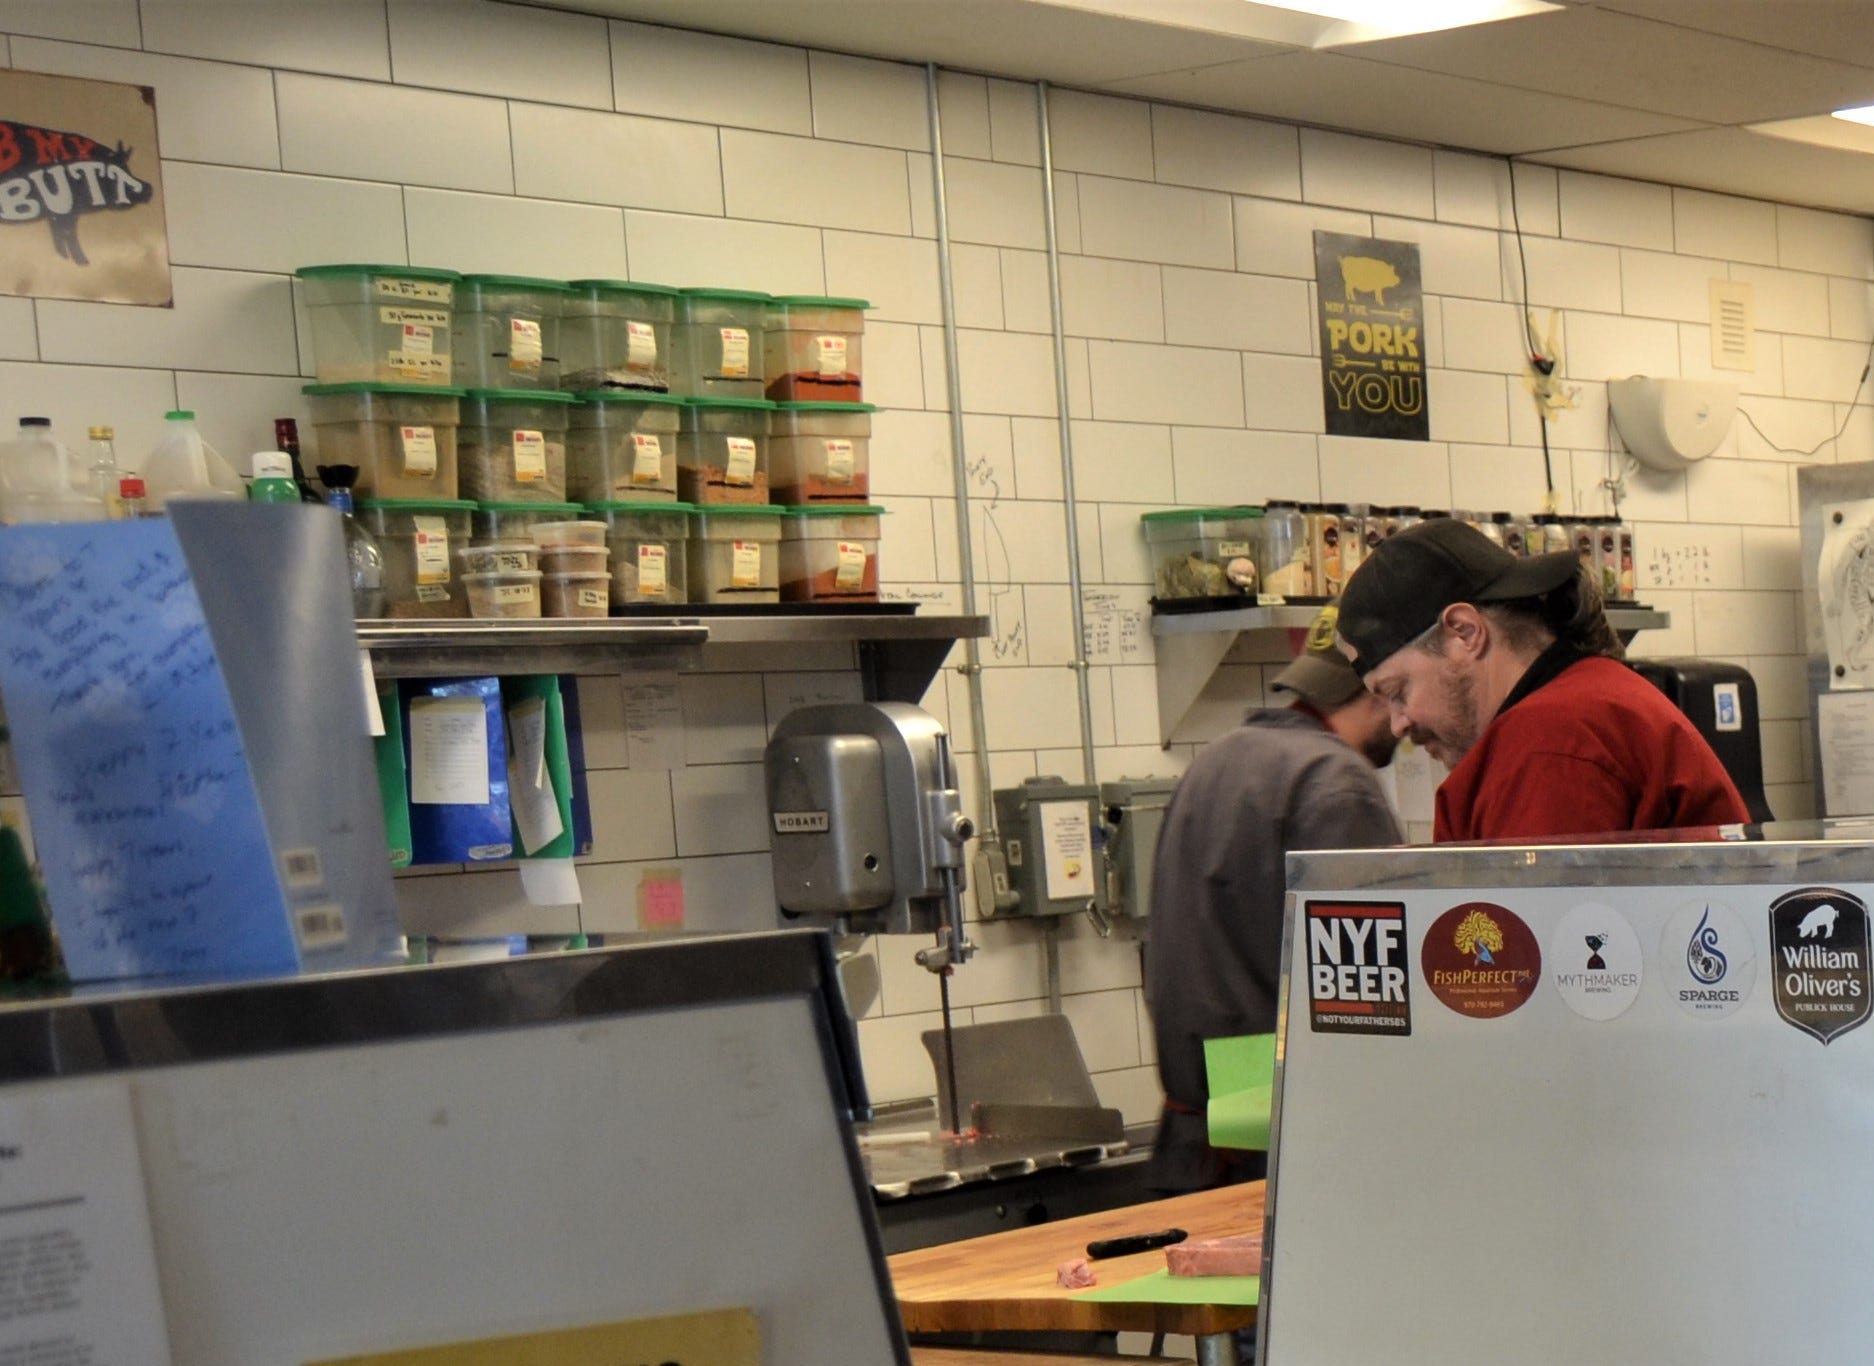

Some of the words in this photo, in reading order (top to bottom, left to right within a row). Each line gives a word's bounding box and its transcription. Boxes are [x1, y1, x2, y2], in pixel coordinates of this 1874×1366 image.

[26, 126, 97, 165] MY
[0, 161, 144, 222] BUTT
[1349, 304, 1369, 317] THE
[1326, 318, 1420, 359] PORK
[1398, 360, 1421, 373] WITH
[1329, 370, 1423, 417] YOU
[779, 815, 825, 827] HOBART
[1310, 918, 1402, 967] NYF
[1782, 945, 1859, 970] William
[1312, 965, 1406, 1002] BEER
[1557, 973, 1638, 988] MYTHMAKER
[1584, 986, 1612, 994] BREWING
[1784, 972, 1862, 998] Oliver's
[1679, 989, 1739, 1002] SPARGE
[1794, 1003, 1828, 1013] PUBLICK
[1829, 1003, 1856, 1013] HOUSE
